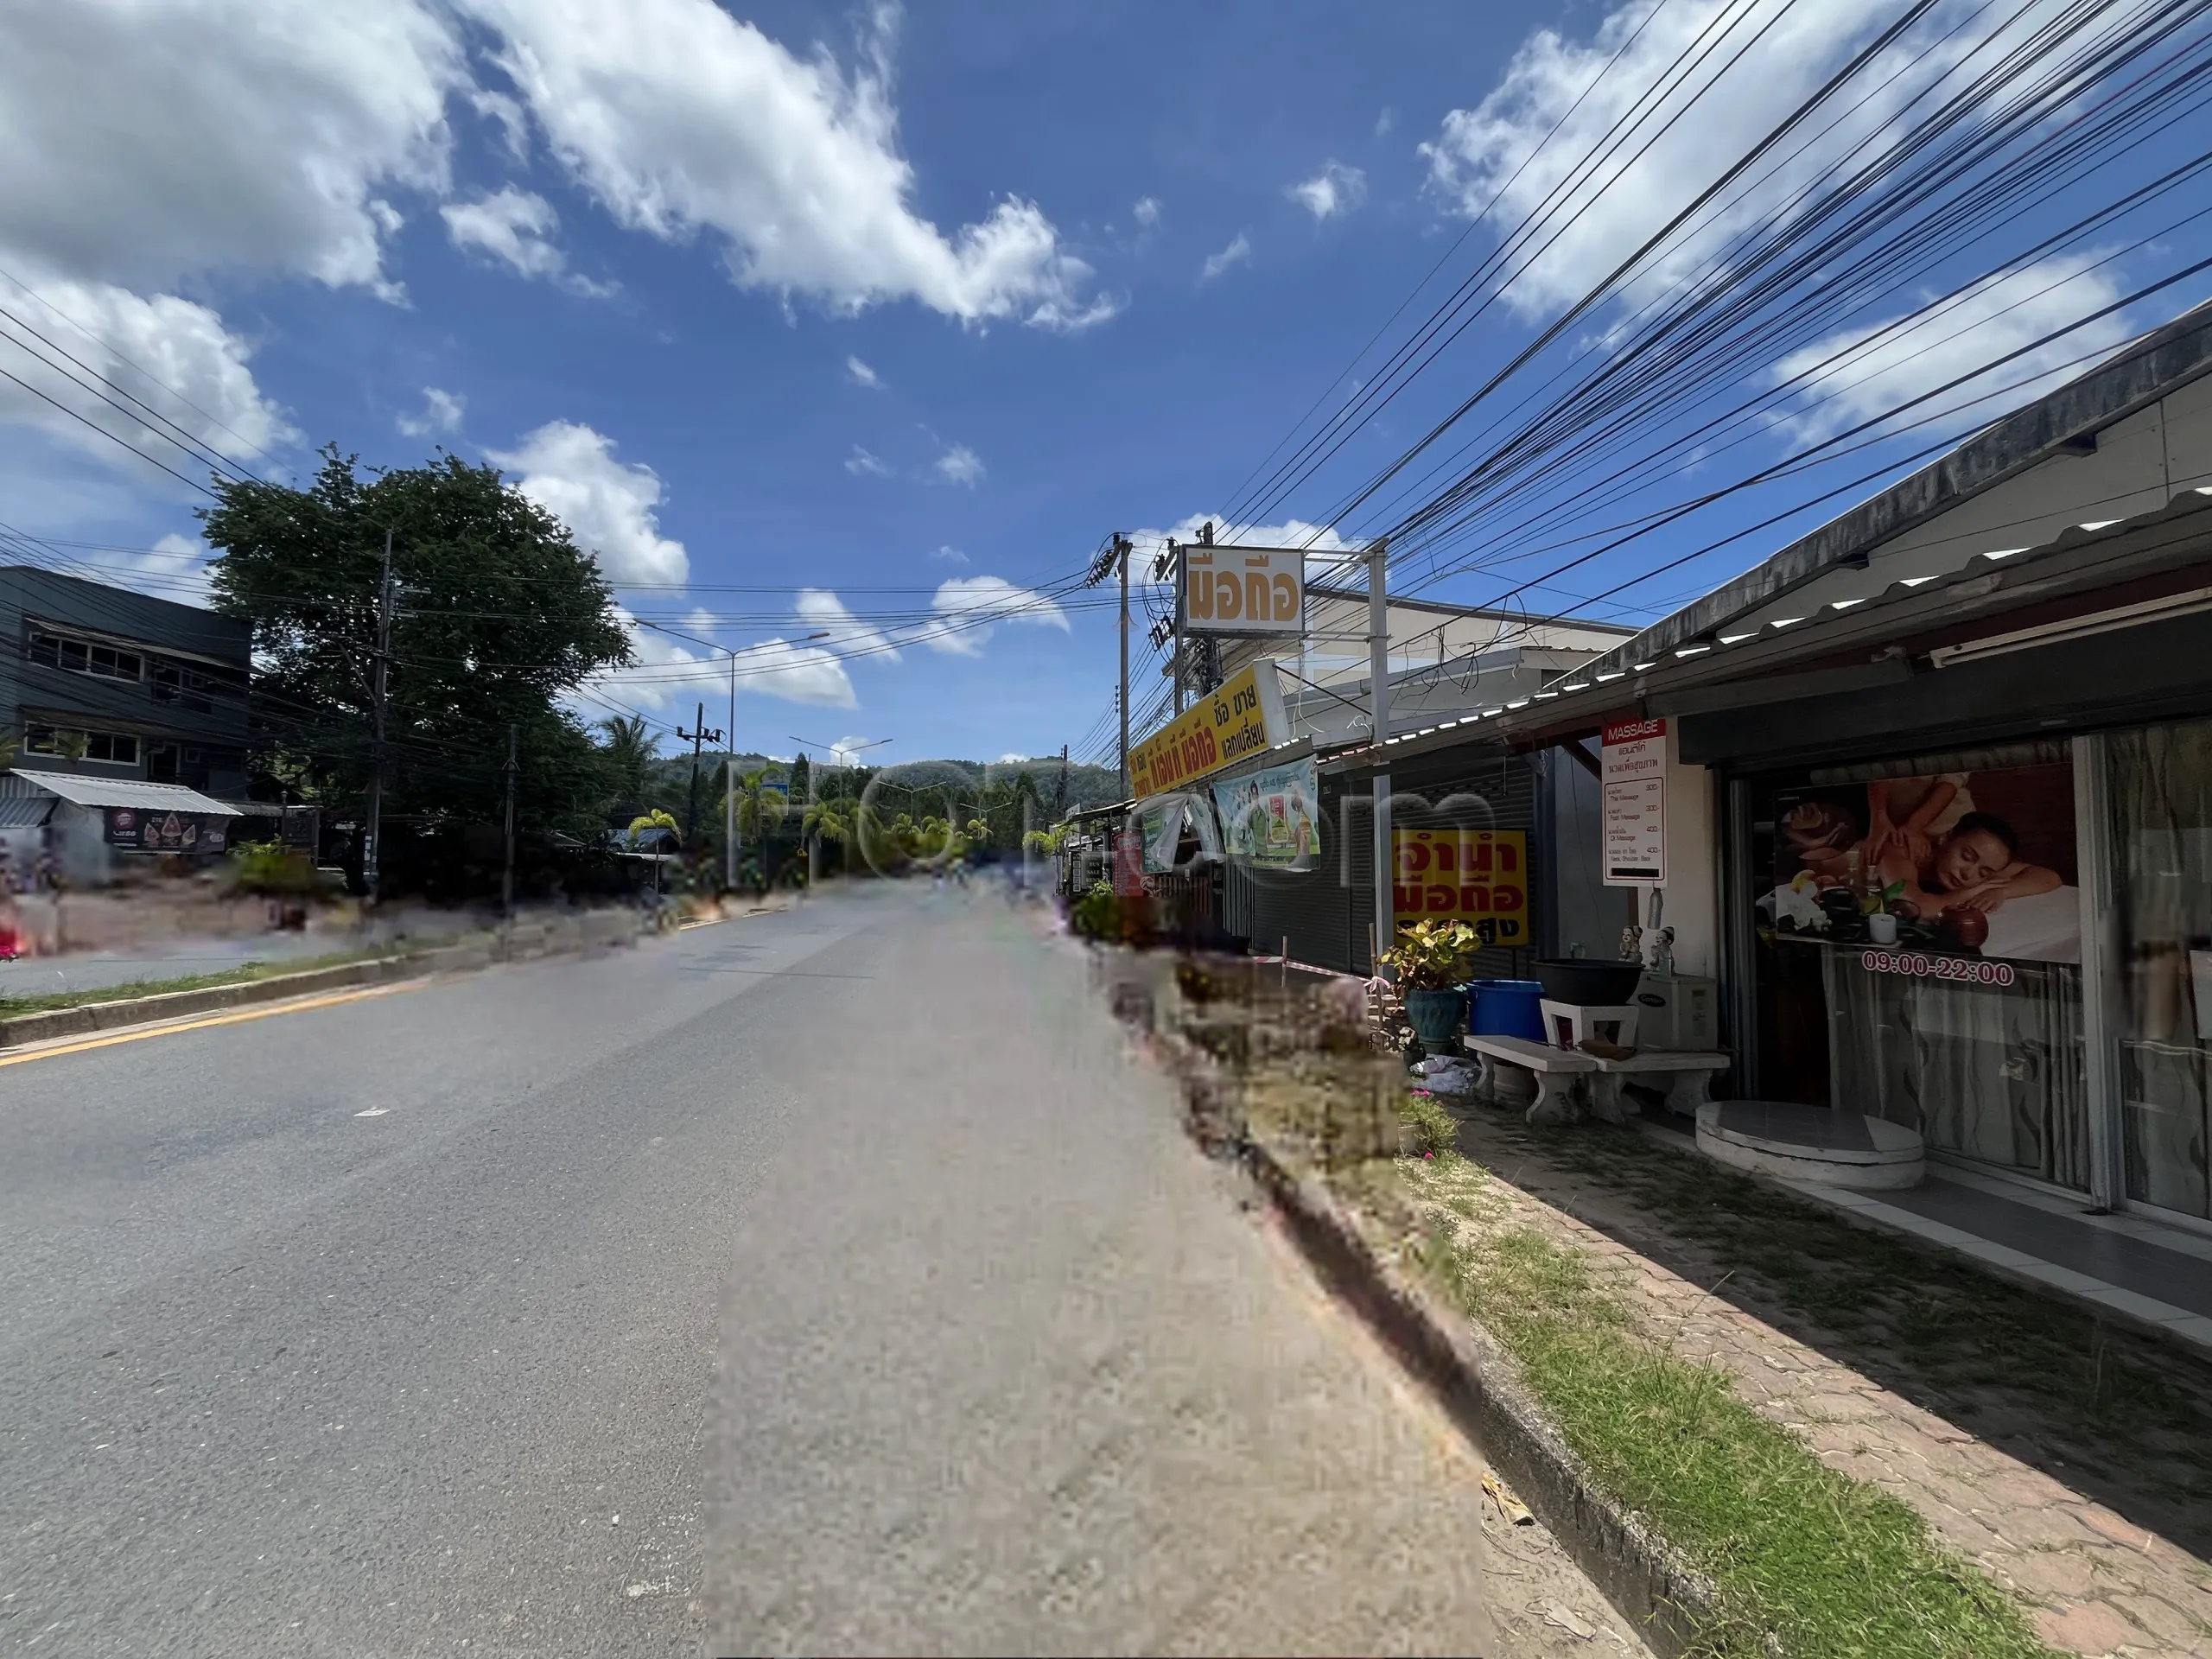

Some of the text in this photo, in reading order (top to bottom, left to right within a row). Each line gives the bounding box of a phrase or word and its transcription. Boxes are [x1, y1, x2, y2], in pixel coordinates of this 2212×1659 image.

[1188, 552, 1299, 621] มือถือ
[1213, 683, 1257, 728] ซื้อ ขาย
[1179, 717, 1217, 775] มือถือ
[1221, 716, 1266, 760] แลกเปลี่ยน
[1607, 719, 1658, 741] MASSAGE
[1395, 832, 1517, 872] จำนำ
[1393, 875, 1523, 913] มือถือ
[1862, 950, 2014, 986] 09:00-22:00
